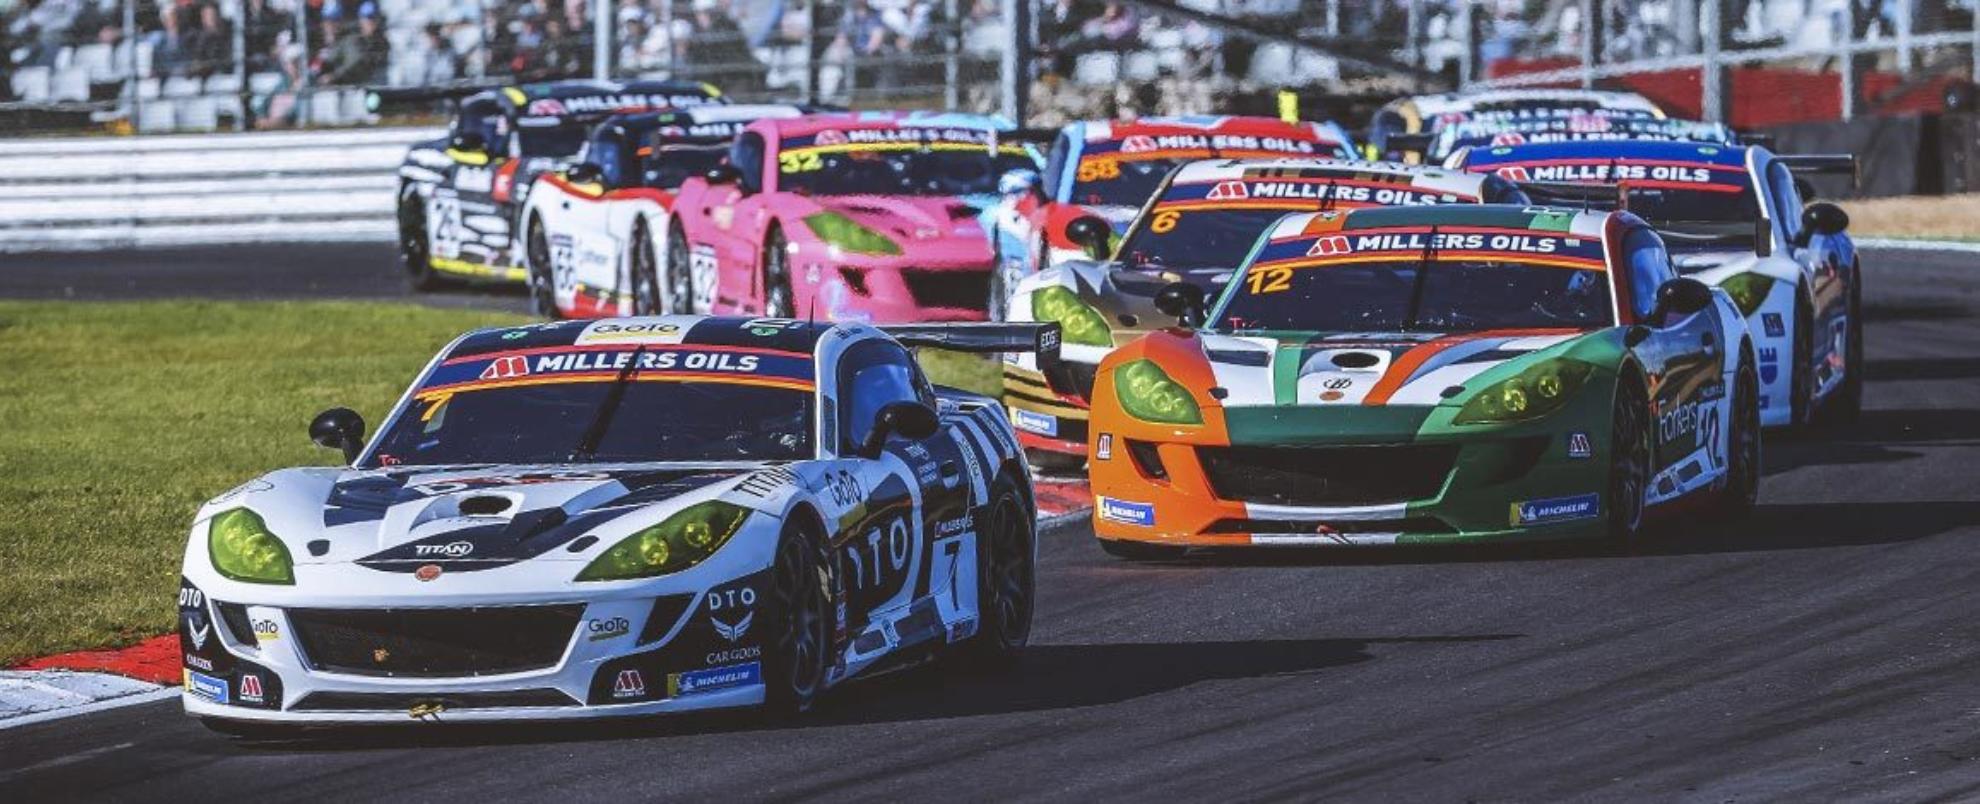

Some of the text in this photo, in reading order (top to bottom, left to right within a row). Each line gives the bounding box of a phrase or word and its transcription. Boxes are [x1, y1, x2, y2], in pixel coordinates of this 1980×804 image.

[1262, 136, 1314, 153] OILS
[779, 151, 823, 173] 32
[1534, 165, 1711, 182] MILLERS OILS
[1376, 189, 1437, 205] OILS
[1150, 212, 1181, 234] 6
[1357, 234, 1557, 252] MILLERS OILS
[1246, 267, 1295, 295] 12
[536, 352, 760, 373] MILLERS OILS
[420, 391, 454, 422] 7
[415, 541, 474, 557] TITAN
[943, 540, 961, 612] 7
[709, 587, 756, 610] DTO
